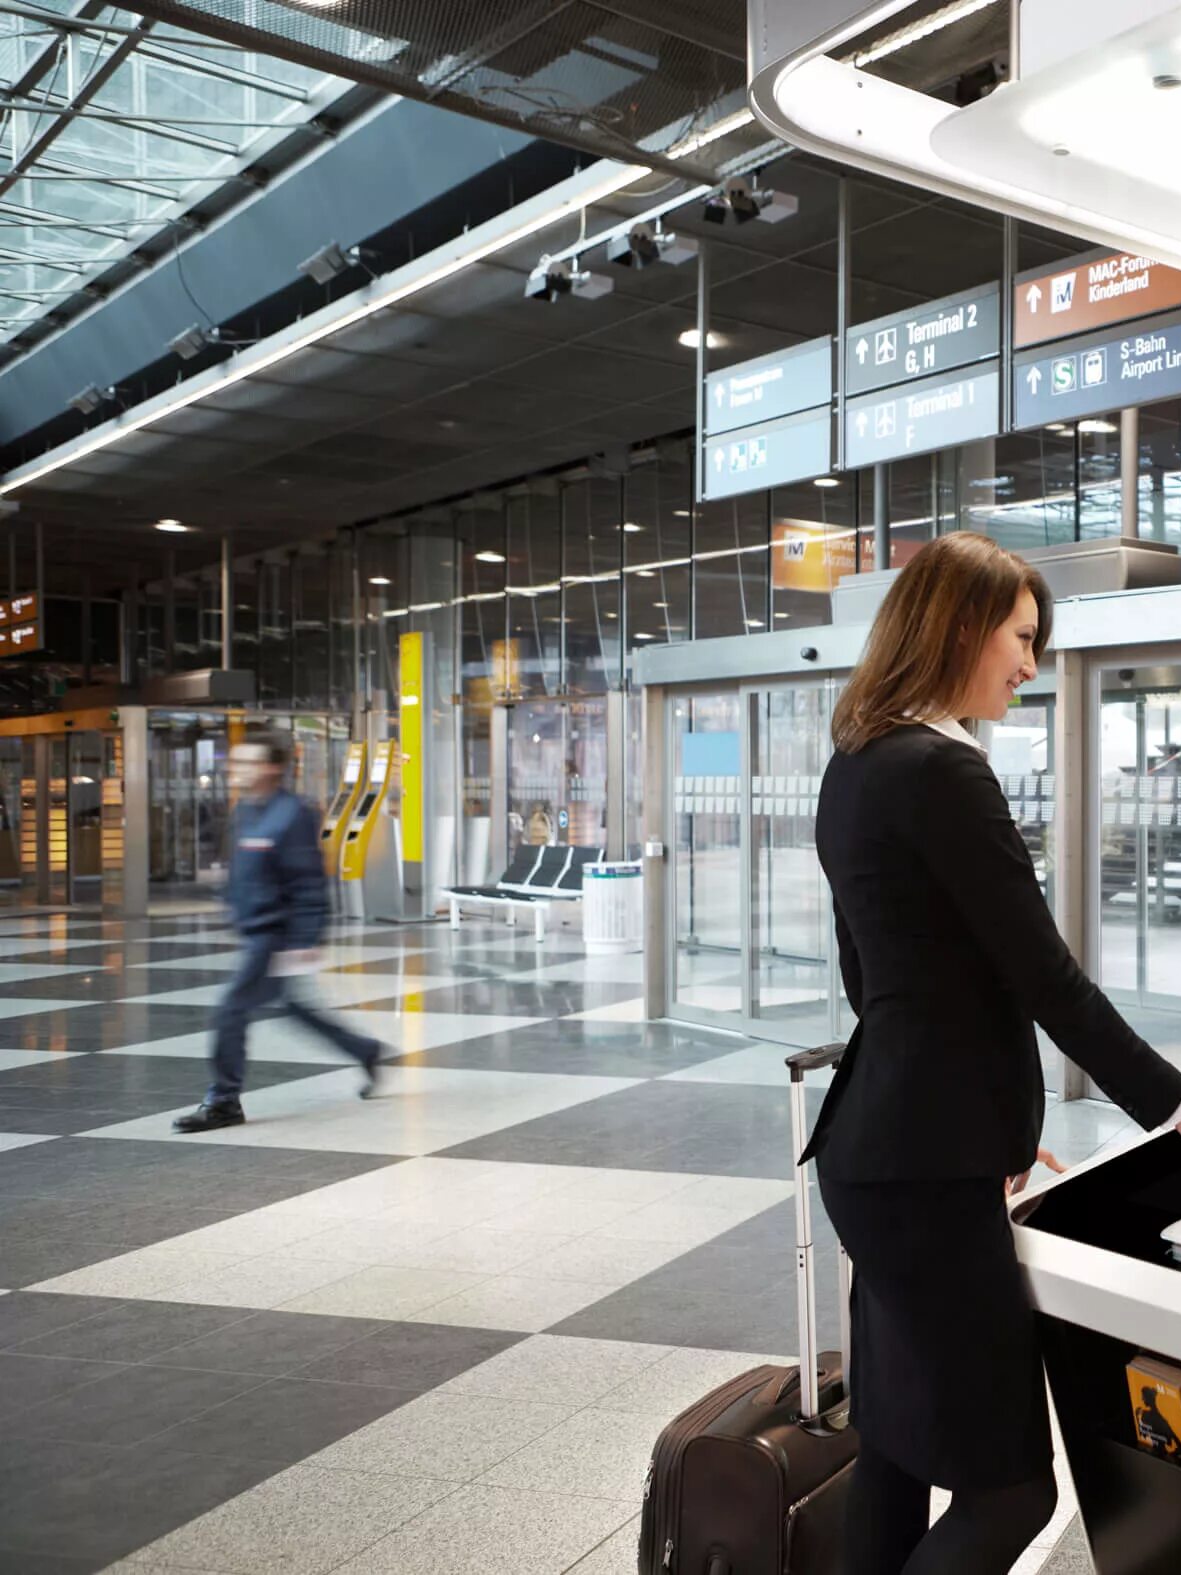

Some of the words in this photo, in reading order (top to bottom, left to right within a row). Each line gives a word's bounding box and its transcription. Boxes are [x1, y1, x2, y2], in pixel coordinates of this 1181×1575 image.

[1088, 270, 1149, 303] Kinderland
[906, 306, 964, 345] Terminal
[967, 304, 977, 328] 2
[905, 350, 919, 374] G,
[924, 344, 935, 368] H
[1120, 336, 1166, 360] S-Bahn
[1120, 358, 1163, 380] Airport
[906, 383, 963, 419] Terminal
[968, 382, 975, 404] 1
[906, 424, 915, 449] F
